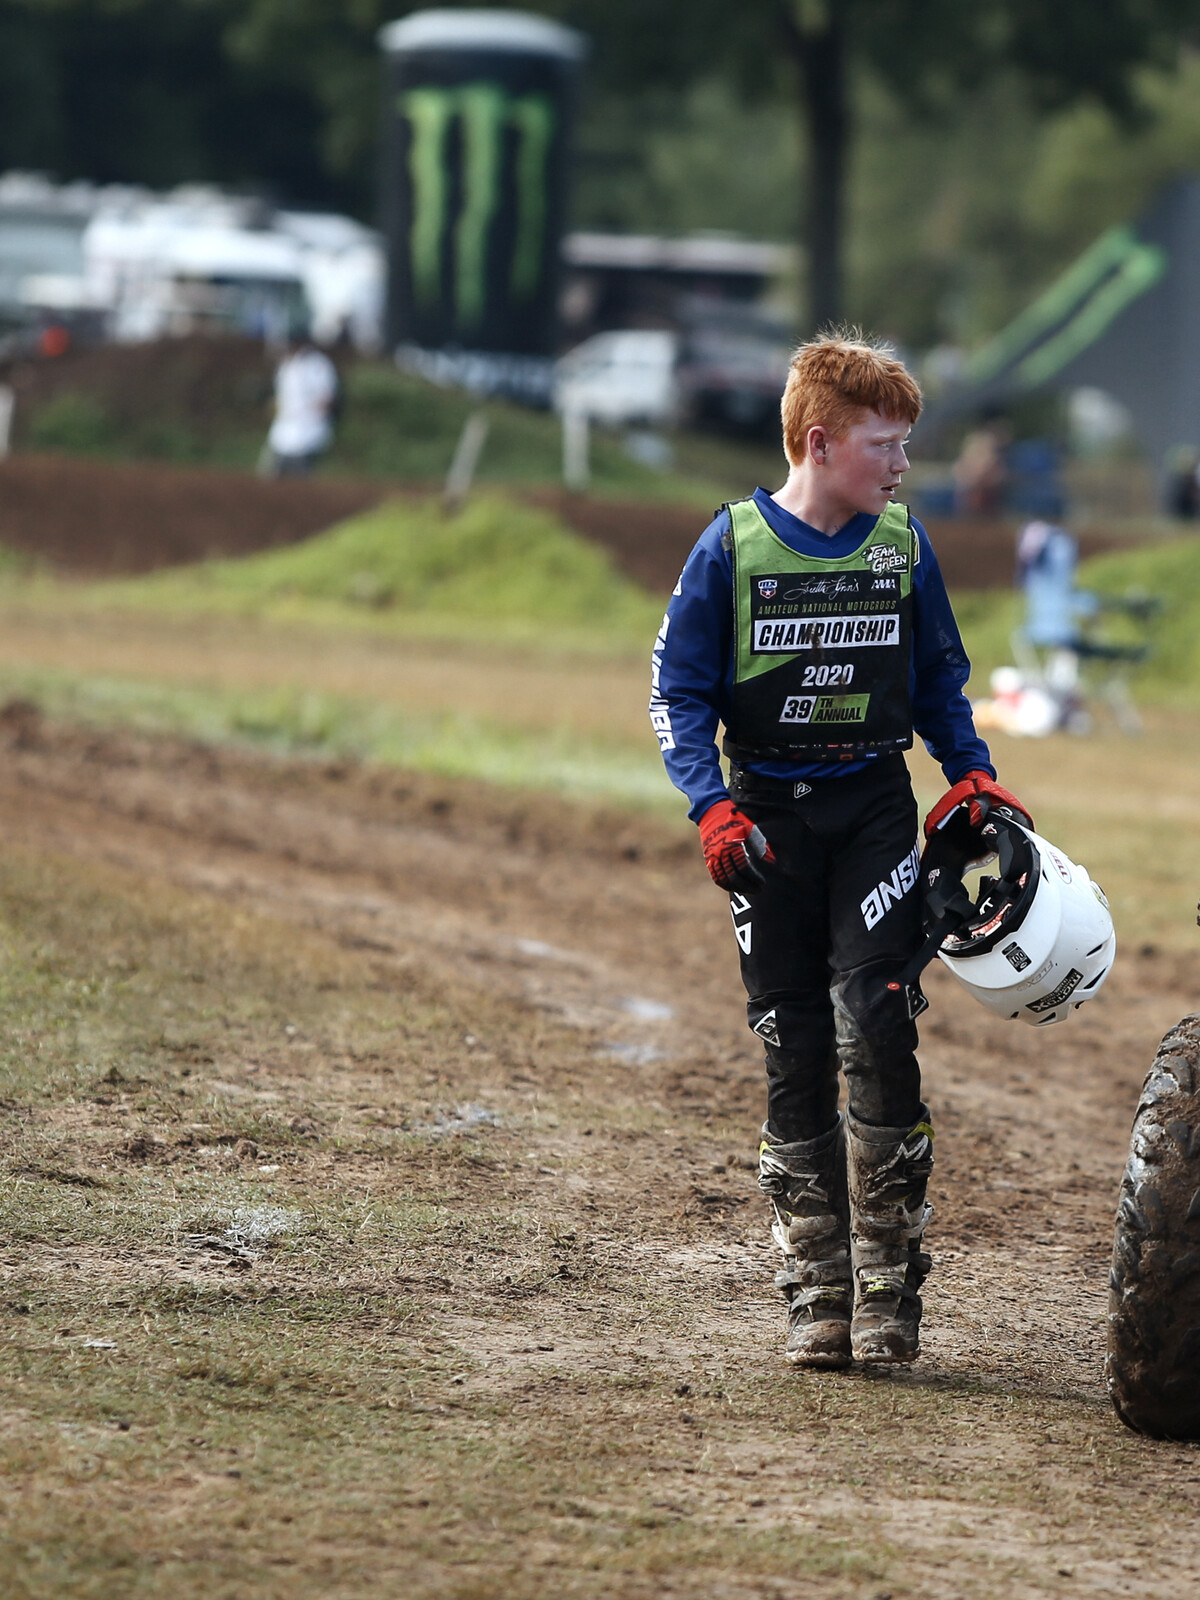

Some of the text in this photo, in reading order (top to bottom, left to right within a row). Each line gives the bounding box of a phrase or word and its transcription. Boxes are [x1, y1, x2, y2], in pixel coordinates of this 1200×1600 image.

[865, 544, 897, 561] TEAM
[872, 555, 908, 573] GREEN
[871, 579, 897, 590] AMA
[758, 601, 897, 615] AMATEUR NATIONAL MOTOCROSS
[759, 619, 897, 647] CHAMPIONSHIP
[801, 664, 854, 687] 2020
[784, 699, 812, 719] 39
[820, 698, 834, 708] TH
[816, 707, 861, 721] ANNUAL
